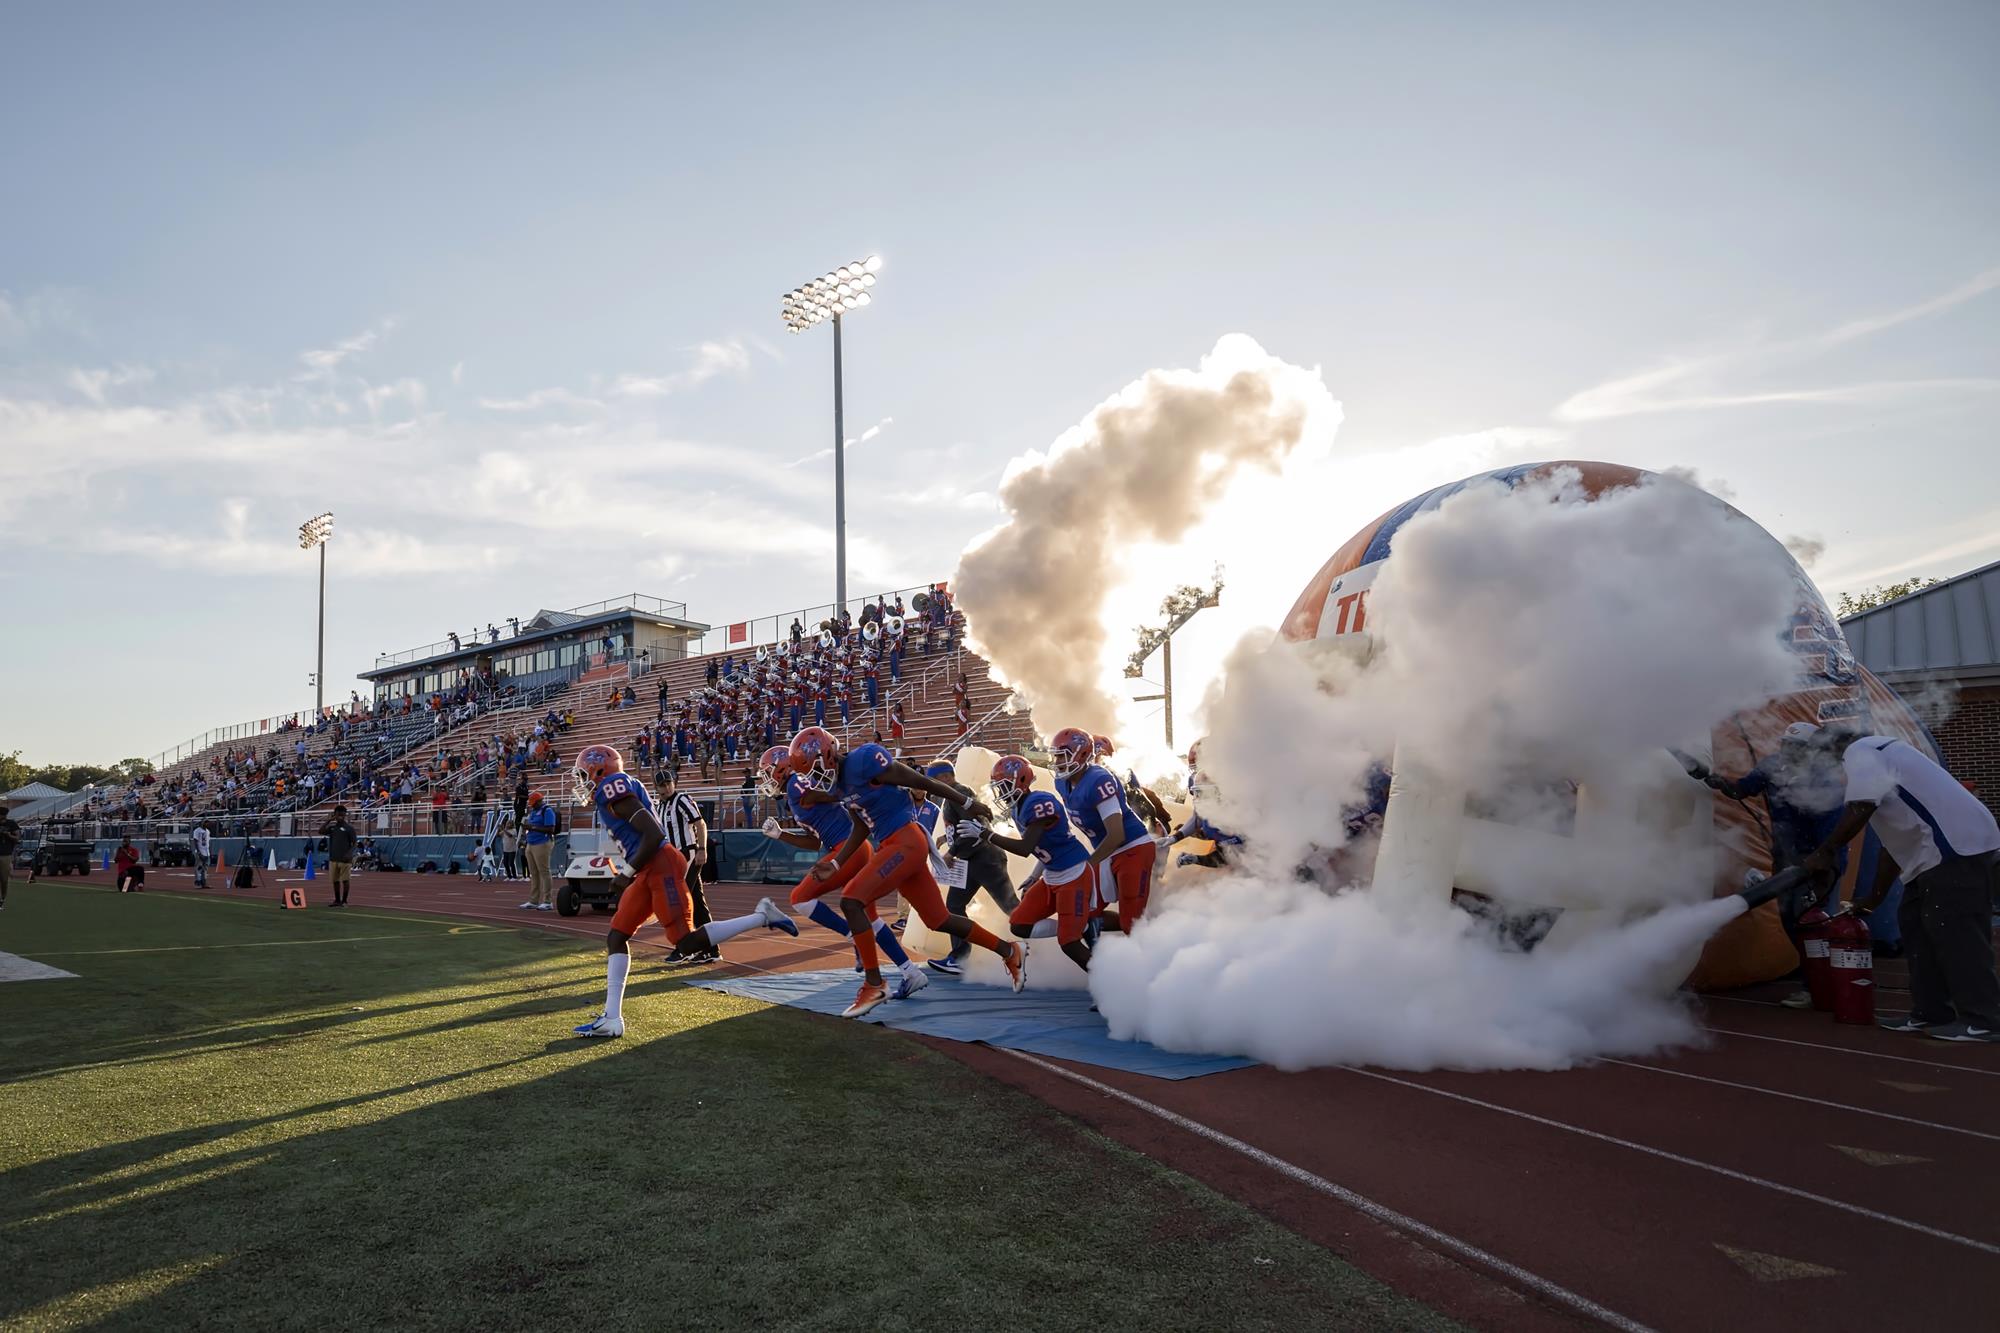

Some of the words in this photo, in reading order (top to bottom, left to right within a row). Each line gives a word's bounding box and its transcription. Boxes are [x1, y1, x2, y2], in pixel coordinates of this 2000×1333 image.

[875, 751, 889, 767] 3
[602, 779, 626, 799] 86
[1097, 781, 1116, 799] 16
[1033, 801, 1055, 818] 23
[290, 889, 303, 906] G
